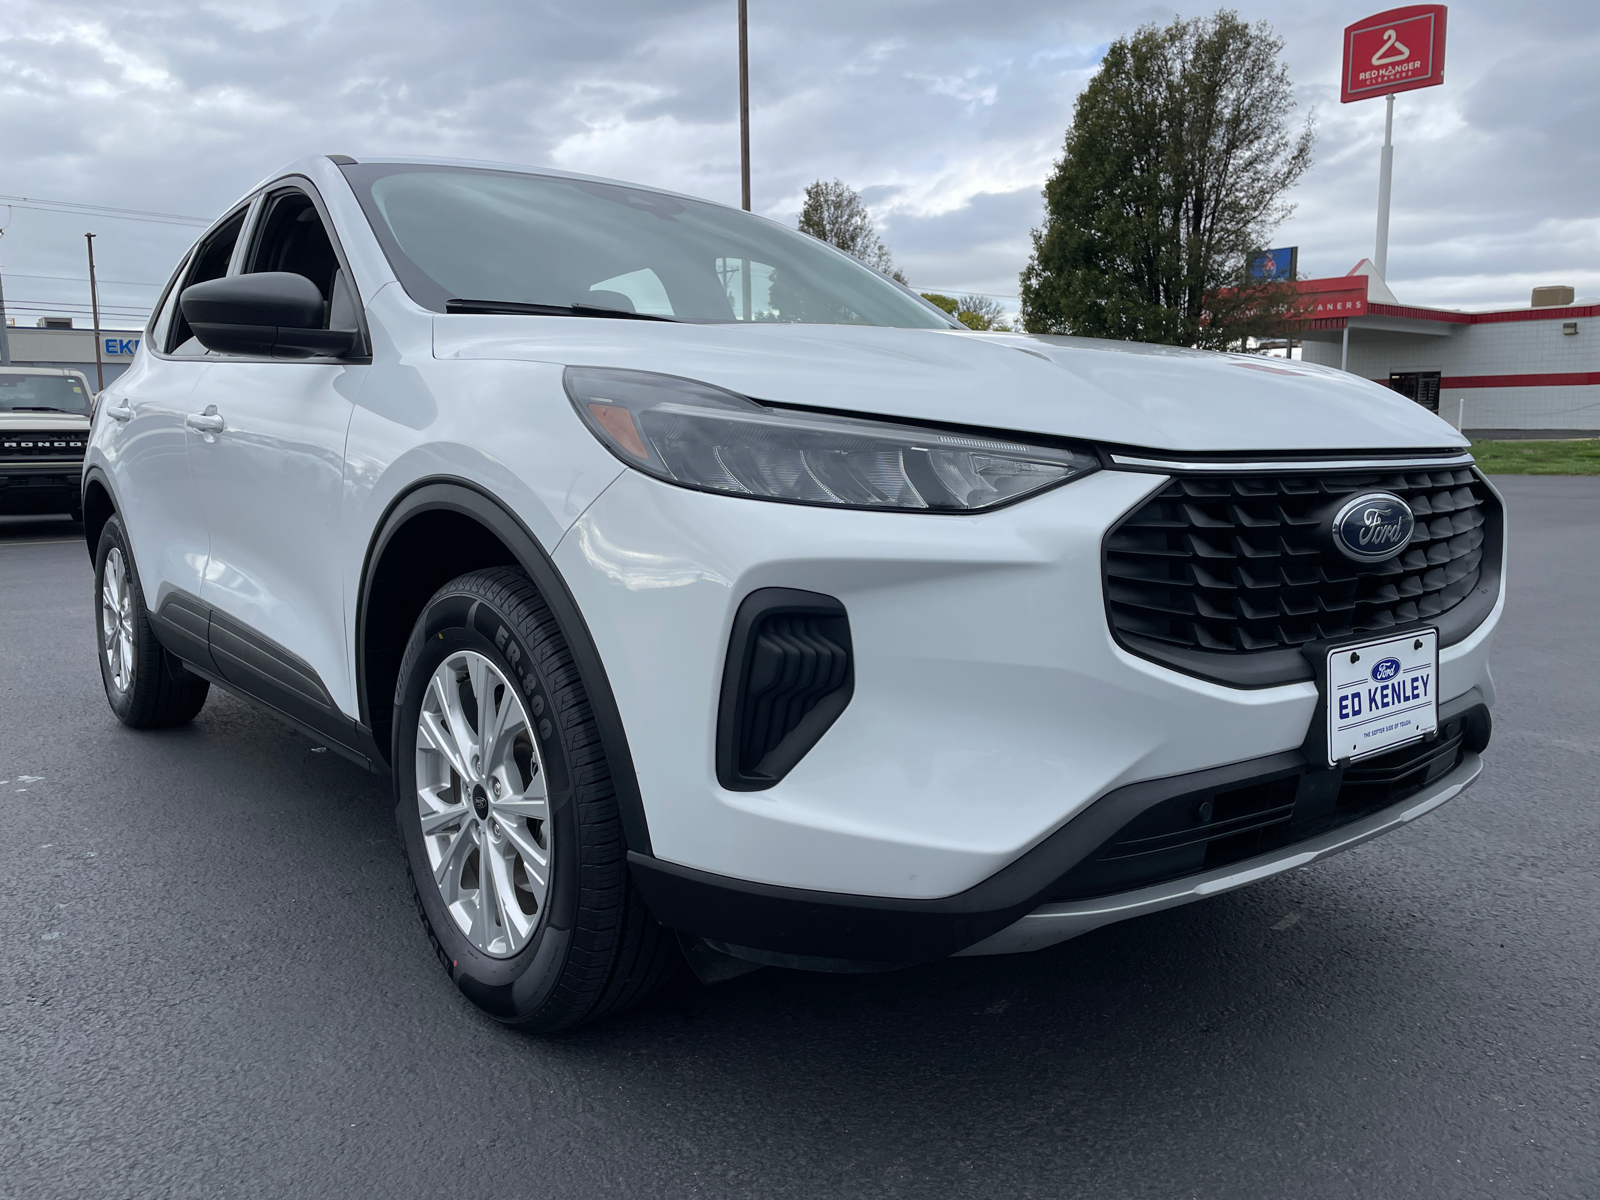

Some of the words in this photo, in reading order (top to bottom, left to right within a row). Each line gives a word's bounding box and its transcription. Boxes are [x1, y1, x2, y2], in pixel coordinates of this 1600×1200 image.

[1359, 69, 1378, 80] RED
[1379, 61, 1421, 76] HANGER
[1366, 71, 1412, 85] CLEANERS
[1358, 508, 1403, 546] Ford
[1376, 661, 1396, 680] Ford
[495, 624, 553, 741] ER-800
[1338, 691, 1362, 720] ED
[1368, 673, 1430, 713] KENLEY
[1371, 727, 1385, 737] SOFTER
[1386, 724, 1394, 732] SIDE
[1394, 722, 1400, 730] OF
